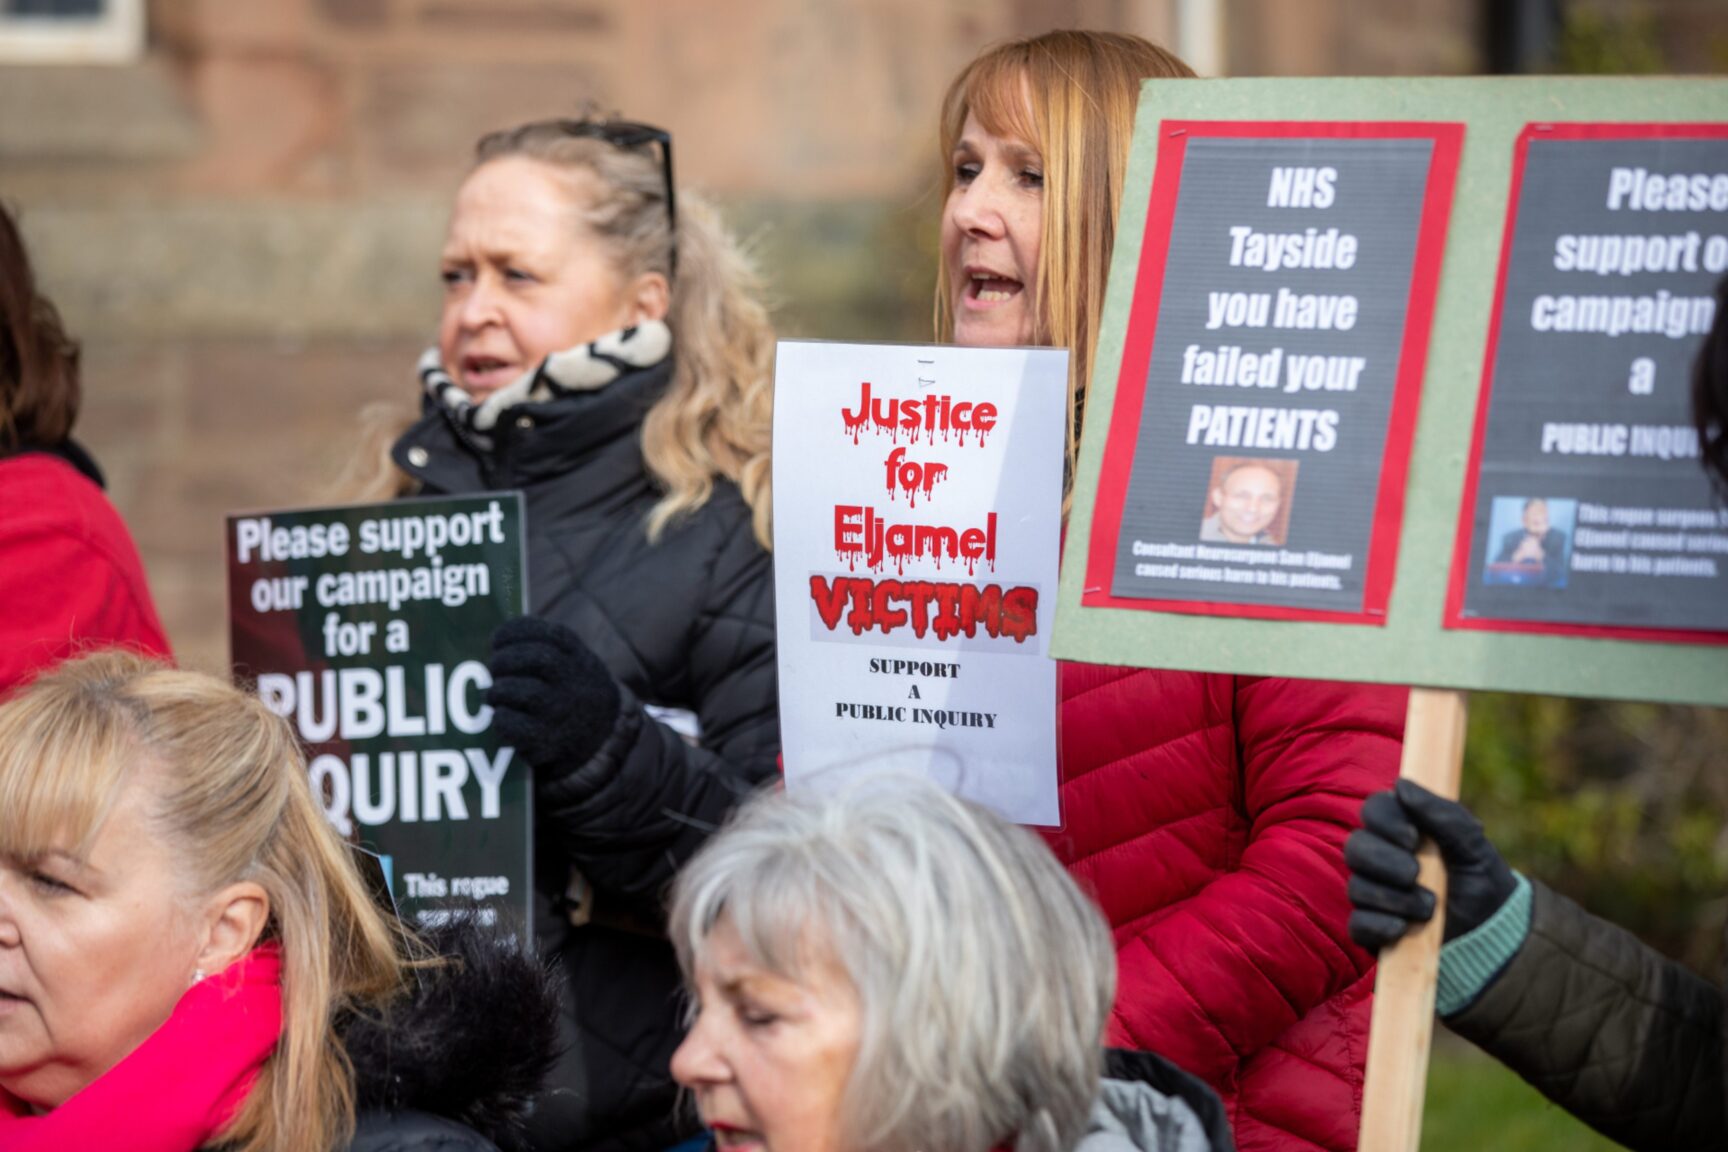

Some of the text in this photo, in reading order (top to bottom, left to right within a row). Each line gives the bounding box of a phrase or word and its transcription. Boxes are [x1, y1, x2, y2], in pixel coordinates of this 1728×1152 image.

[1267, 166, 1338, 209] NHS
[1606, 167, 1728, 211] Please
[1228, 226, 1358, 272] Tayside
[1553, 231, 1701, 275] support
[1205, 288, 1358, 331] you have
[1531, 290, 1717, 339] campaign
[1180, 344, 1366, 393] failed your
[1628, 356, 1657, 395] a
[841, 382, 998, 447] Justice
[1186, 405, 1340, 452] PATIENTS
[1541, 422, 1700, 461] PUBLIC INQUI
[884, 447, 949, 508] for
[235, 501, 505, 564] Please support
[834, 504, 998, 576] Eljamel
[250, 557, 491, 613] our campaign
[809, 574, 1039, 644] VICTIMS
[323, 613, 410, 657] for a
[869, 658, 961, 679] SUPPORT
[256, 660, 495, 744] PUBLIC
[908, 685, 922, 700] A
[835, 702, 998, 730] PUBLIC INQUIRY
[308, 746, 516, 837] QUIRY
[402, 871, 448, 898] This
